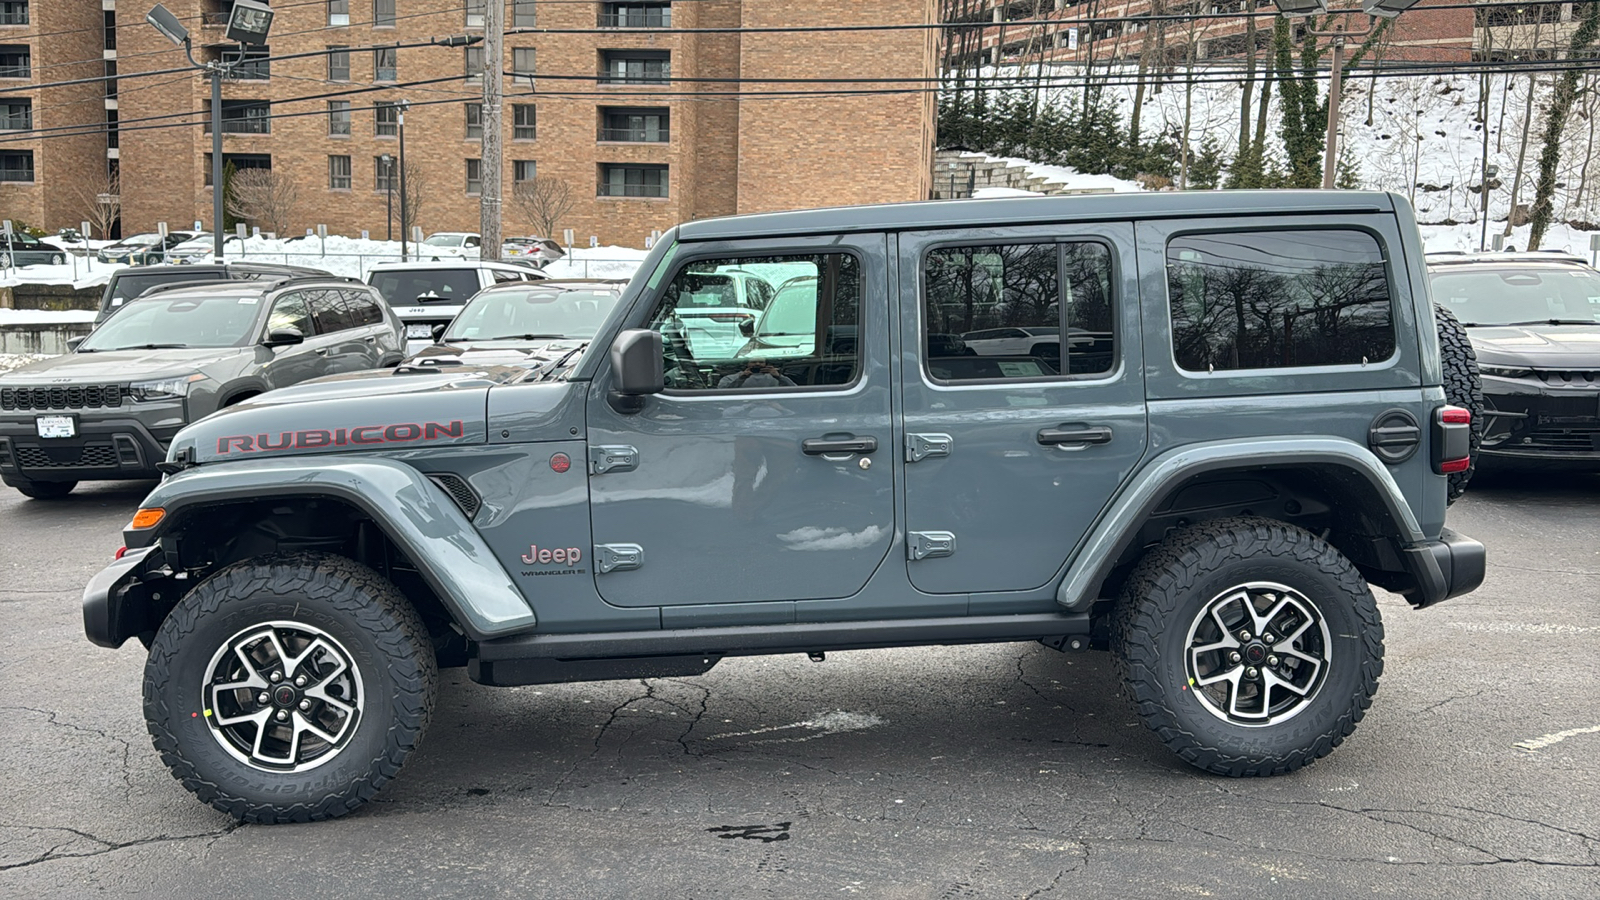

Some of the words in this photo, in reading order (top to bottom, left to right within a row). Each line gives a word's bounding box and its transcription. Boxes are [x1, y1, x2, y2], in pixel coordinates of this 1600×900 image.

[216, 420, 463, 454] RUBICON
[521, 544, 582, 567] Jeep
[521, 569, 576, 577] WRANGLER
